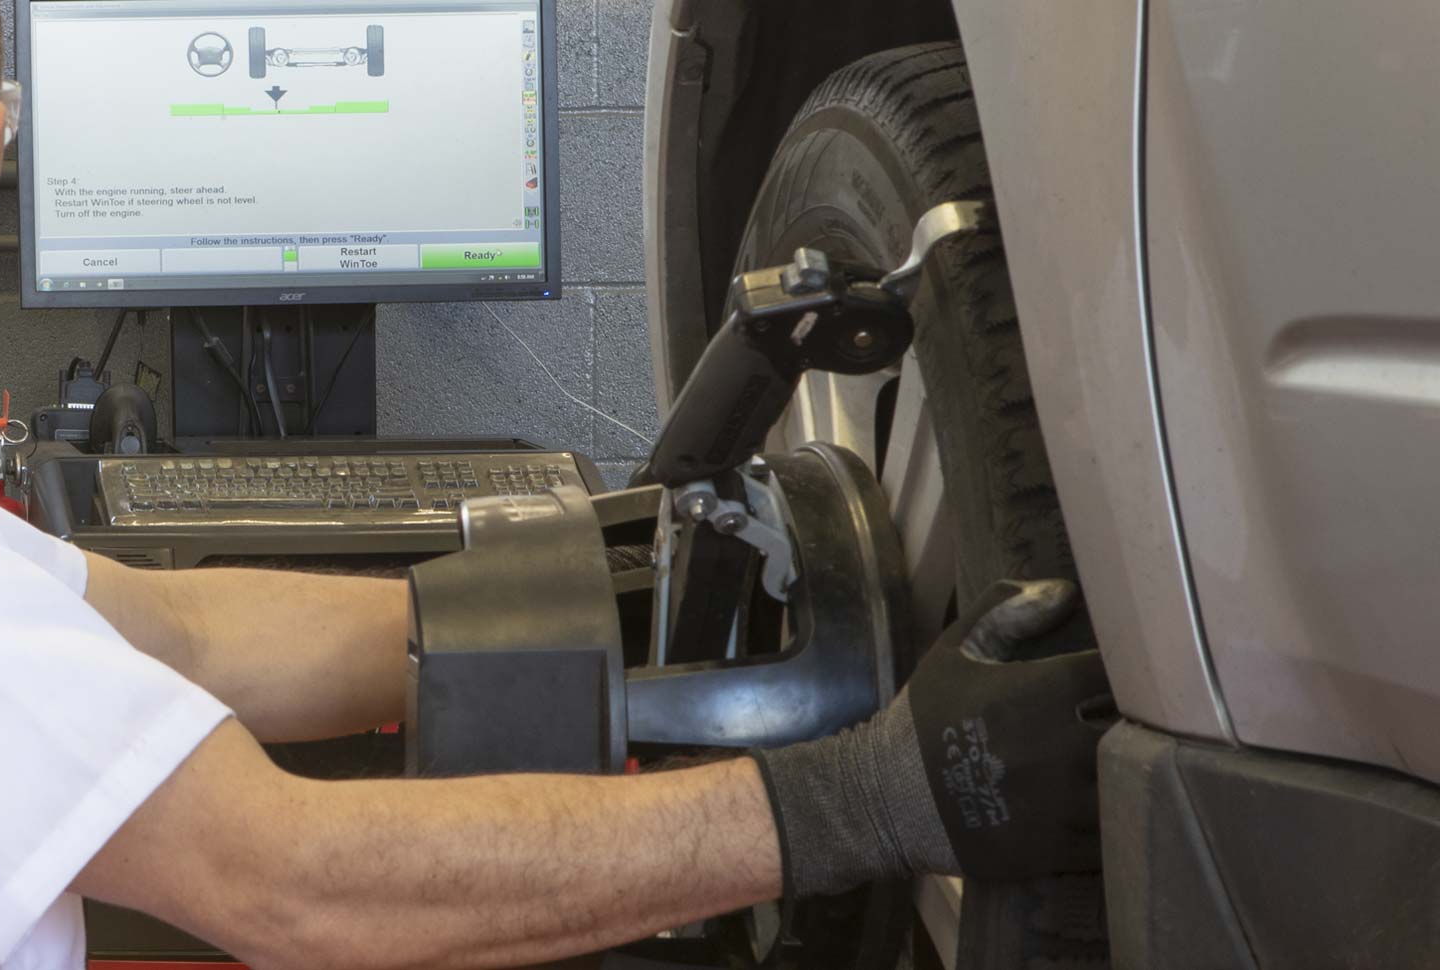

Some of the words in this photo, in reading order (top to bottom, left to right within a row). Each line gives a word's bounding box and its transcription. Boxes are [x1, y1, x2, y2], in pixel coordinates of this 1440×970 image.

[47, 177, 68, 187] Step
[55, 188, 77, 196] With
[79, 188, 94, 196] the
[96, 188, 128, 197] engine
[130, 187, 168, 197] running,
[170, 186, 193, 195] steer
[195, 185, 227, 194] ahead.
[55, 199, 88, 207] Restart
[91, 198, 126, 207] WinToe
[127, 198, 134, 206] if
[136, 197, 174, 208] steering
[176, 196, 204, 205] wheel
[206, 196, 215, 205] is
[217, 196, 232, 204] not
[234, 195, 258, 204] level.
[55, 210, 75, 218] Turn
[77, 209, 90, 218] off
[92, 209, 107, 217] the
[110, 209, 143, 219] engine.
[190, 237, 221, 246] Follow
[223, 237, 238, 245] the
[241, 236, 297, 246] instructions,
[299, 235, 319, 245] then
[322, 236, 347, 246] press
[340, 247, 377, 257] Restart
[464, 250, 496, 261] Ready
[82, 257, 118, 267] Cancel
[340, 259, 378, 269] WinToe
[279, 292, 306, 302] acer
